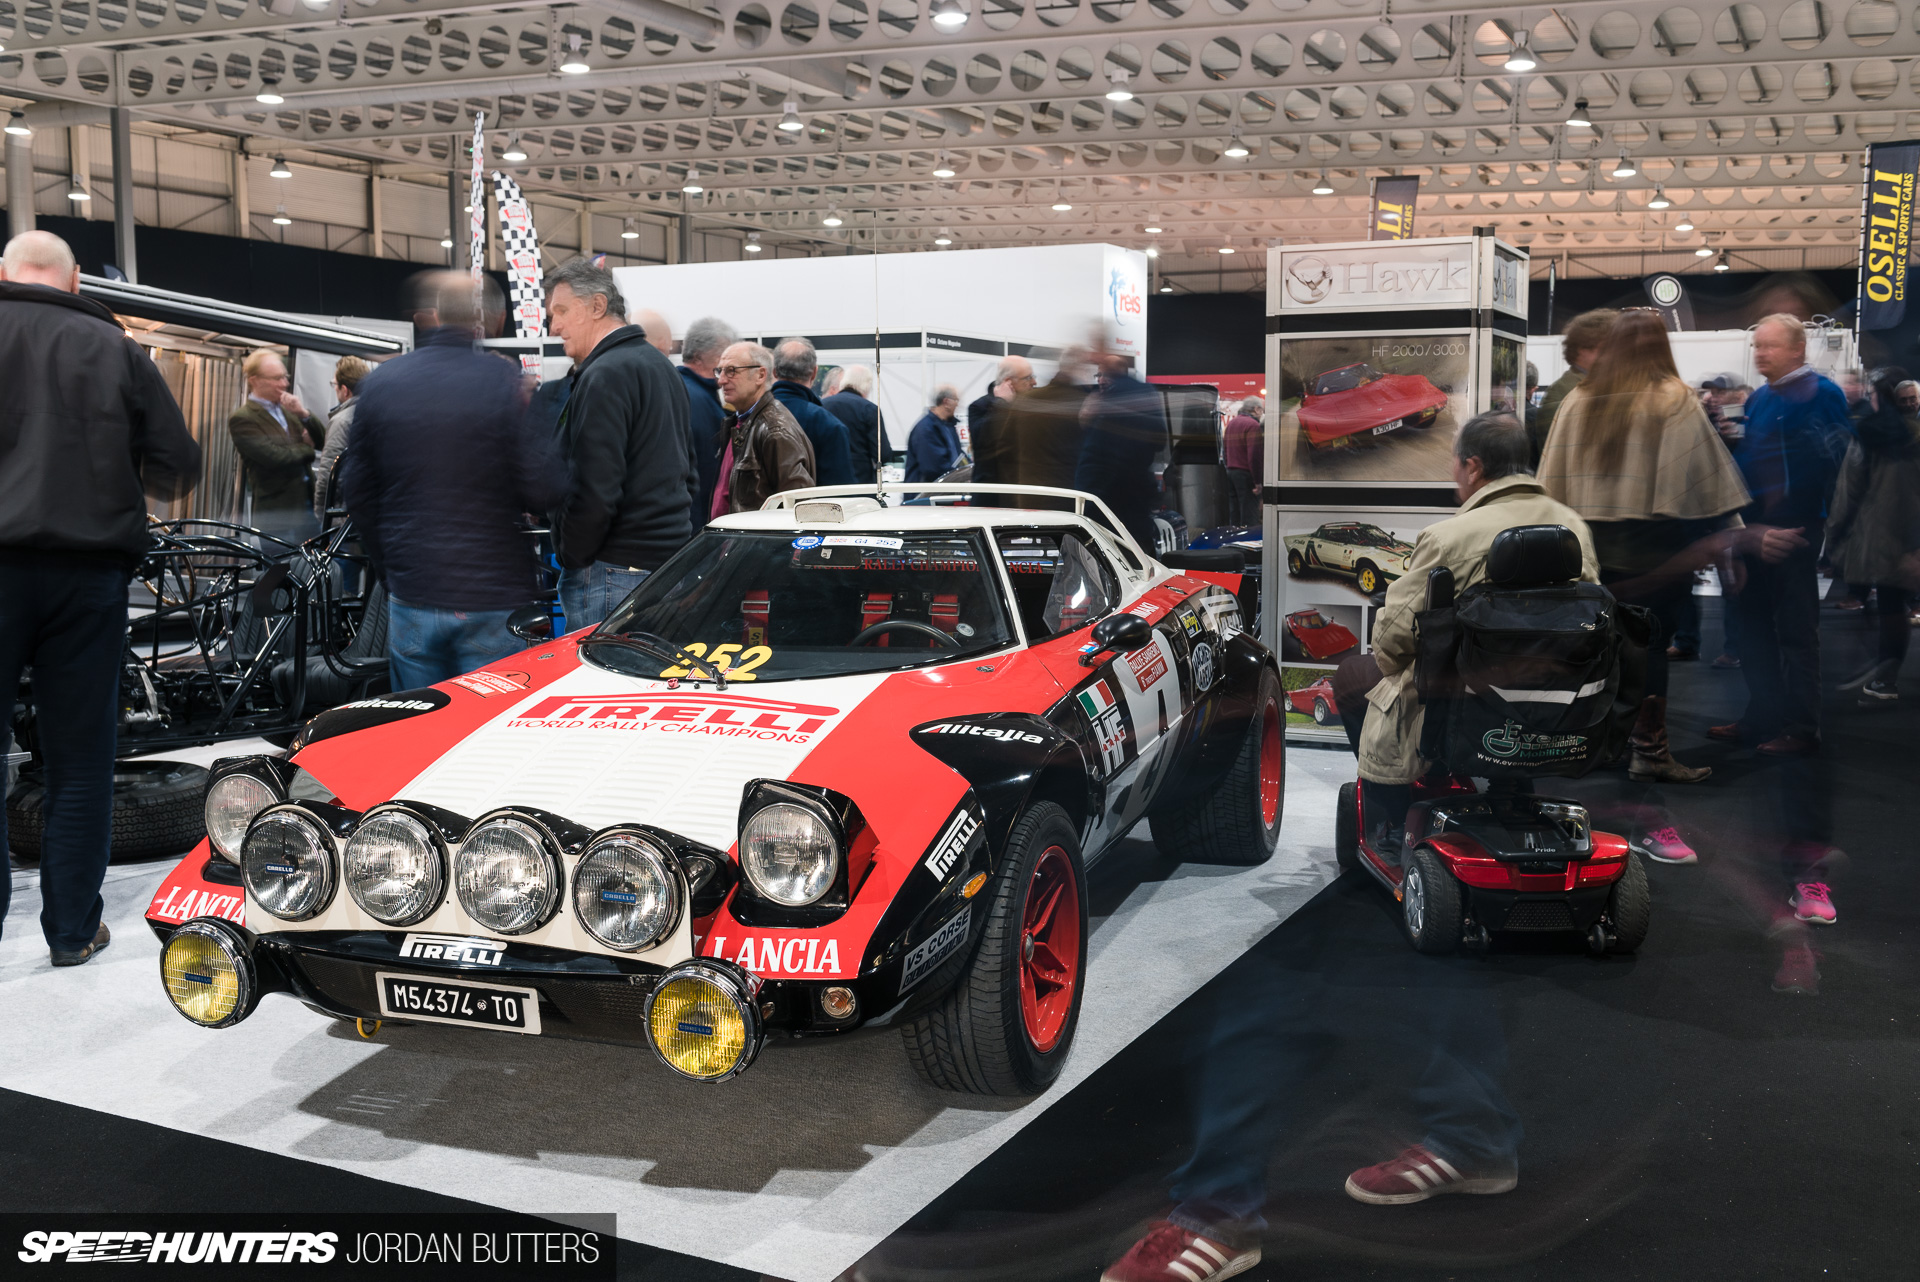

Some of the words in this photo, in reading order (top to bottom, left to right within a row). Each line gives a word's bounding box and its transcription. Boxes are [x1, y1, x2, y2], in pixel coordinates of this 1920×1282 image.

[1902, 173, 1914, 202] CARS
[1867, 169, 1903, 303] OSELLI
[1898, 202, 1911, 245] SPORTS
[1898, 244, 1907, 256] &
[1338, 257, 1468, 294] Hawk
[1895, 257, 1907, 301] CLASSIC
[1120, 283, 1141, 314] reis
[1372, 346, 1386, 357] HF
[864, 558, 905, 571] RALLY
[1009, 561, 1043, 574] NCIA
[660, 643, 772, 681] 252
[331, 698, 435, 710] Alitalia
[517, 692, 840, 733] PIRELLI
[507, 720, 584, 729] WORLD
[589, 720, 656, 731] RALLY
[660, 723, 810, 744] CHAMPIONS
[918, 724, 1044, 744] Alitalia
[1520, 747, 1568, 759] Mobility
[924, 809, 979, 882] PIRELLI
[266, 865, 293, 873] CARELLO
[157, 886, 245, 925] LANCIA
[604, 893, 635, 901] CARELLO
[399, 933, 508, 966] PIRELLI
[713, 937, 841, 973] LANCIA
[907, 947, 924, 971] VS
[928, 908, 970, 955] CORSE
[394, 984, 474, 1016] M54374
[491, 996, 518, 1022] TO
